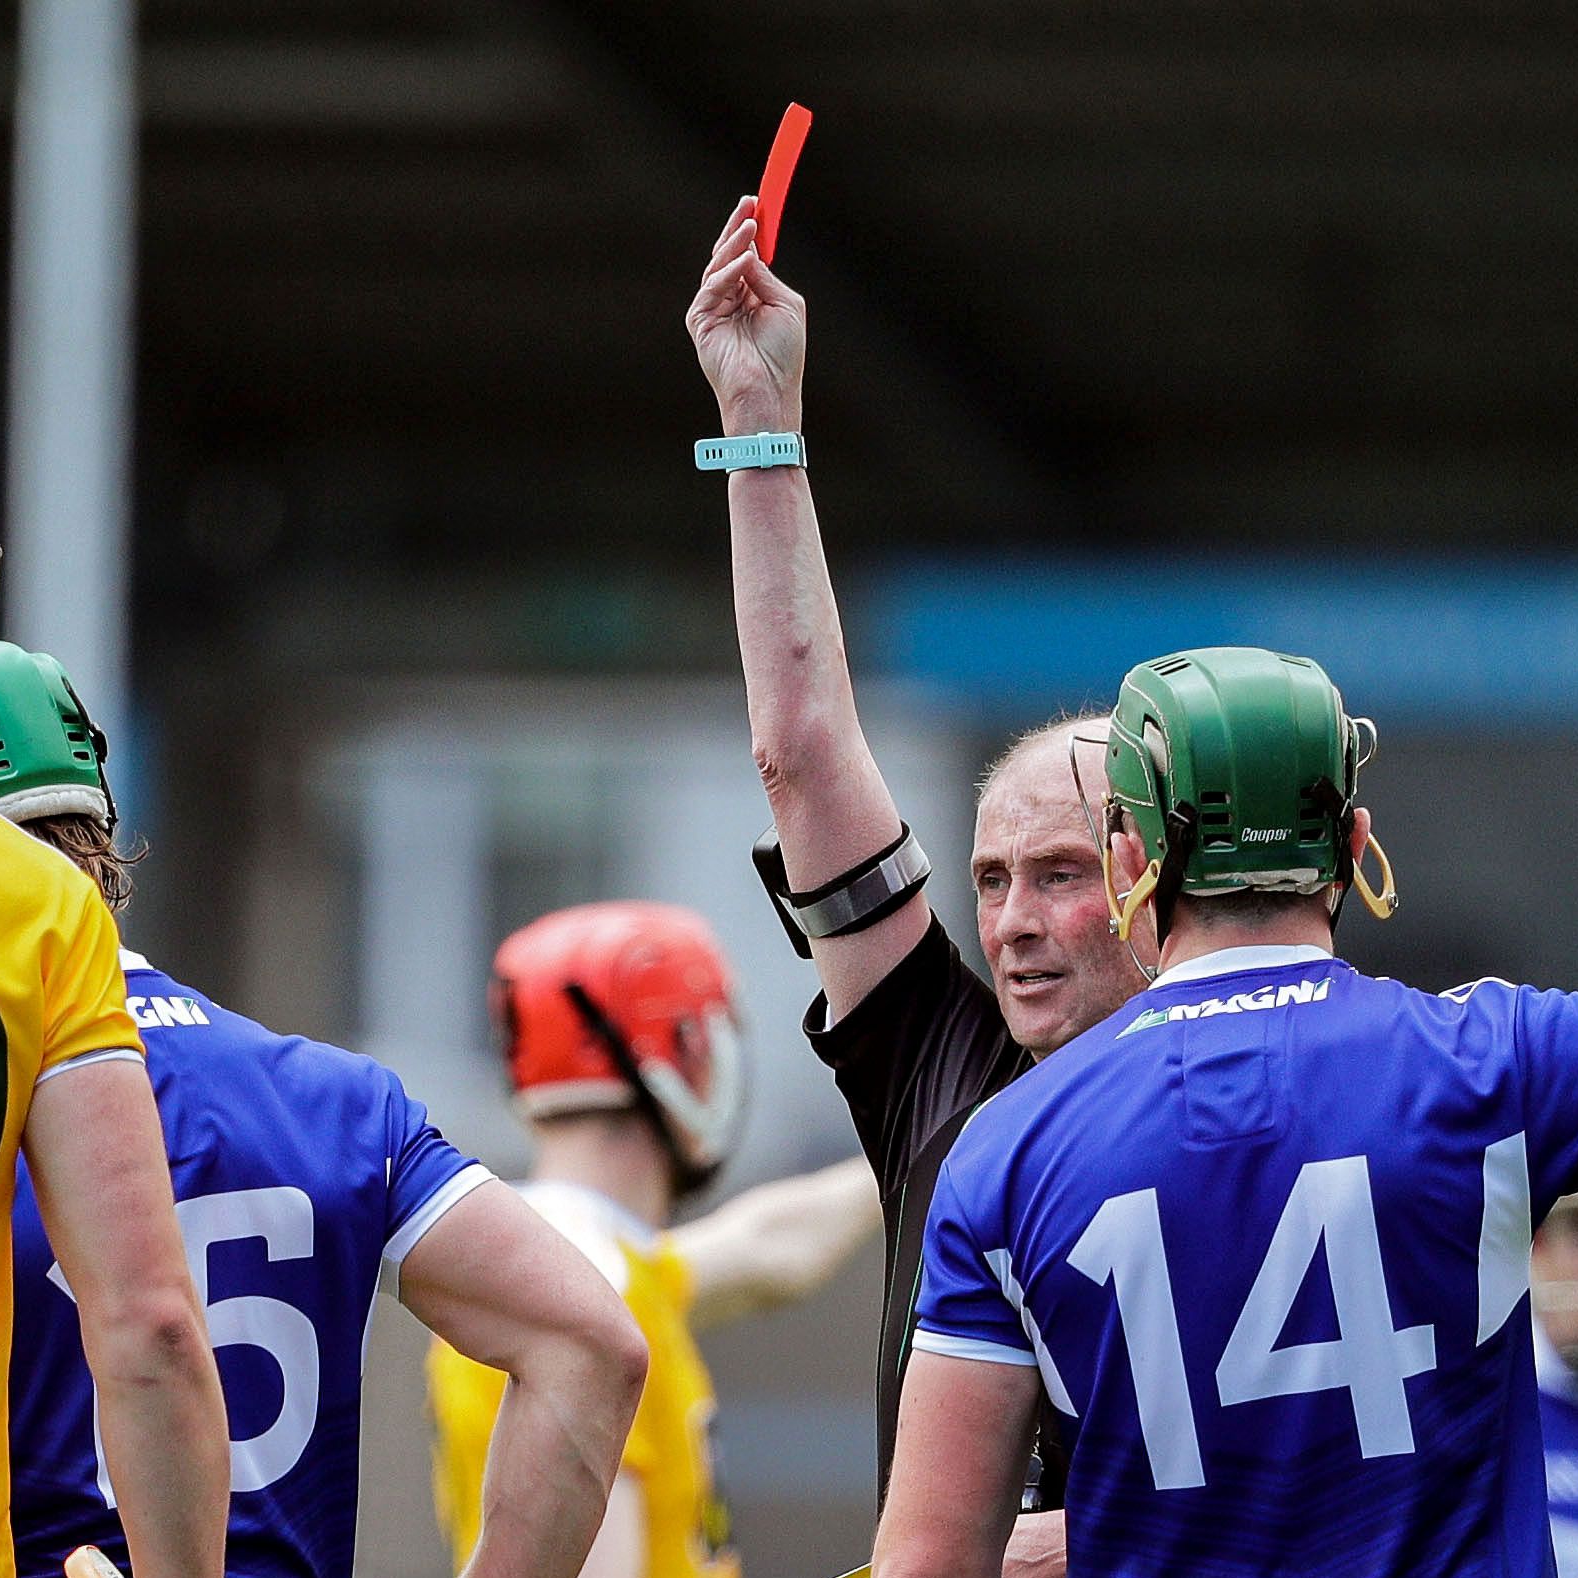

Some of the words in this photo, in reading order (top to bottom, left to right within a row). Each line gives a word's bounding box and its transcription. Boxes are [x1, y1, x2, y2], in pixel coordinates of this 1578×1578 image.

[1241, 827, 1292, 843] Cooper
[126, 996, 210, 1028] GNI
[1066, 1155, 1437, 1490] 14
